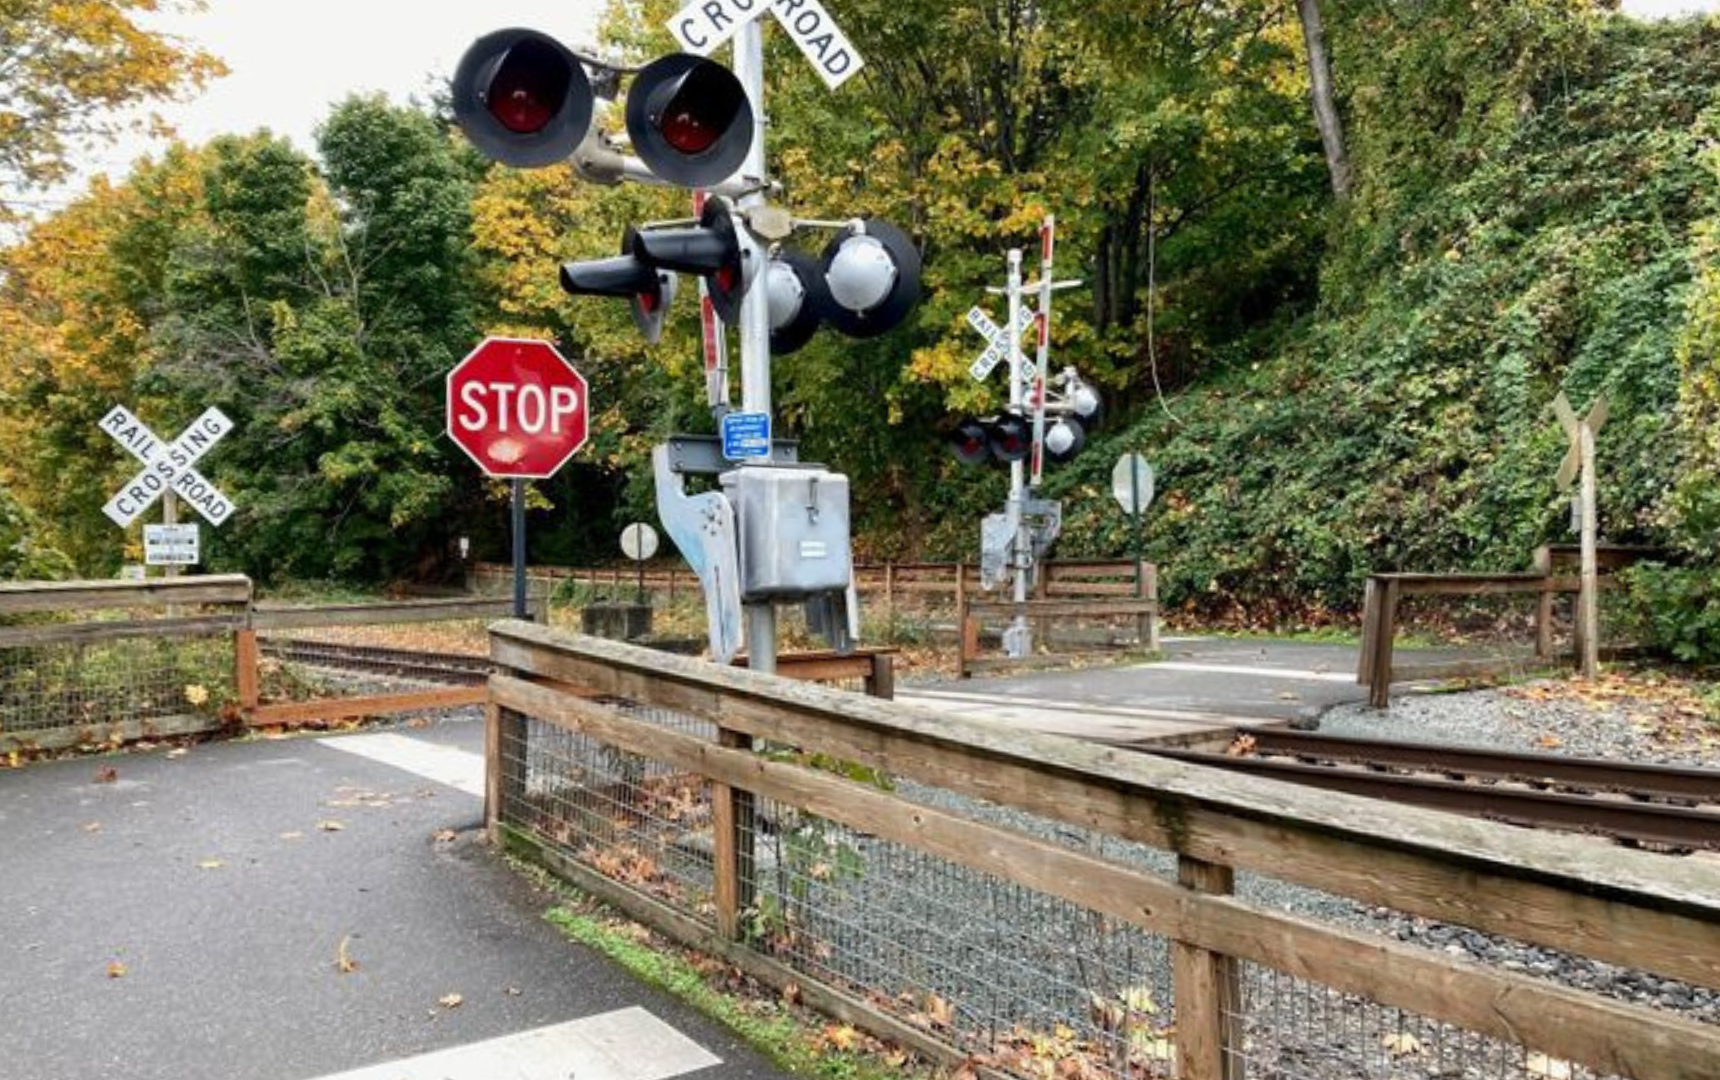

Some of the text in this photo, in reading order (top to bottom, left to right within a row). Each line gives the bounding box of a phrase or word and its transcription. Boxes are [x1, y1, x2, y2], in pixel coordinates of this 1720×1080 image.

[968, 309, 997, 339] RAIL
[458, 380, 579, 434] STOP
[106, 411, 155, 460] RAIL
[116, 418, 221, 516] CROSSING
[177, 472, 226, 518] ROAD
